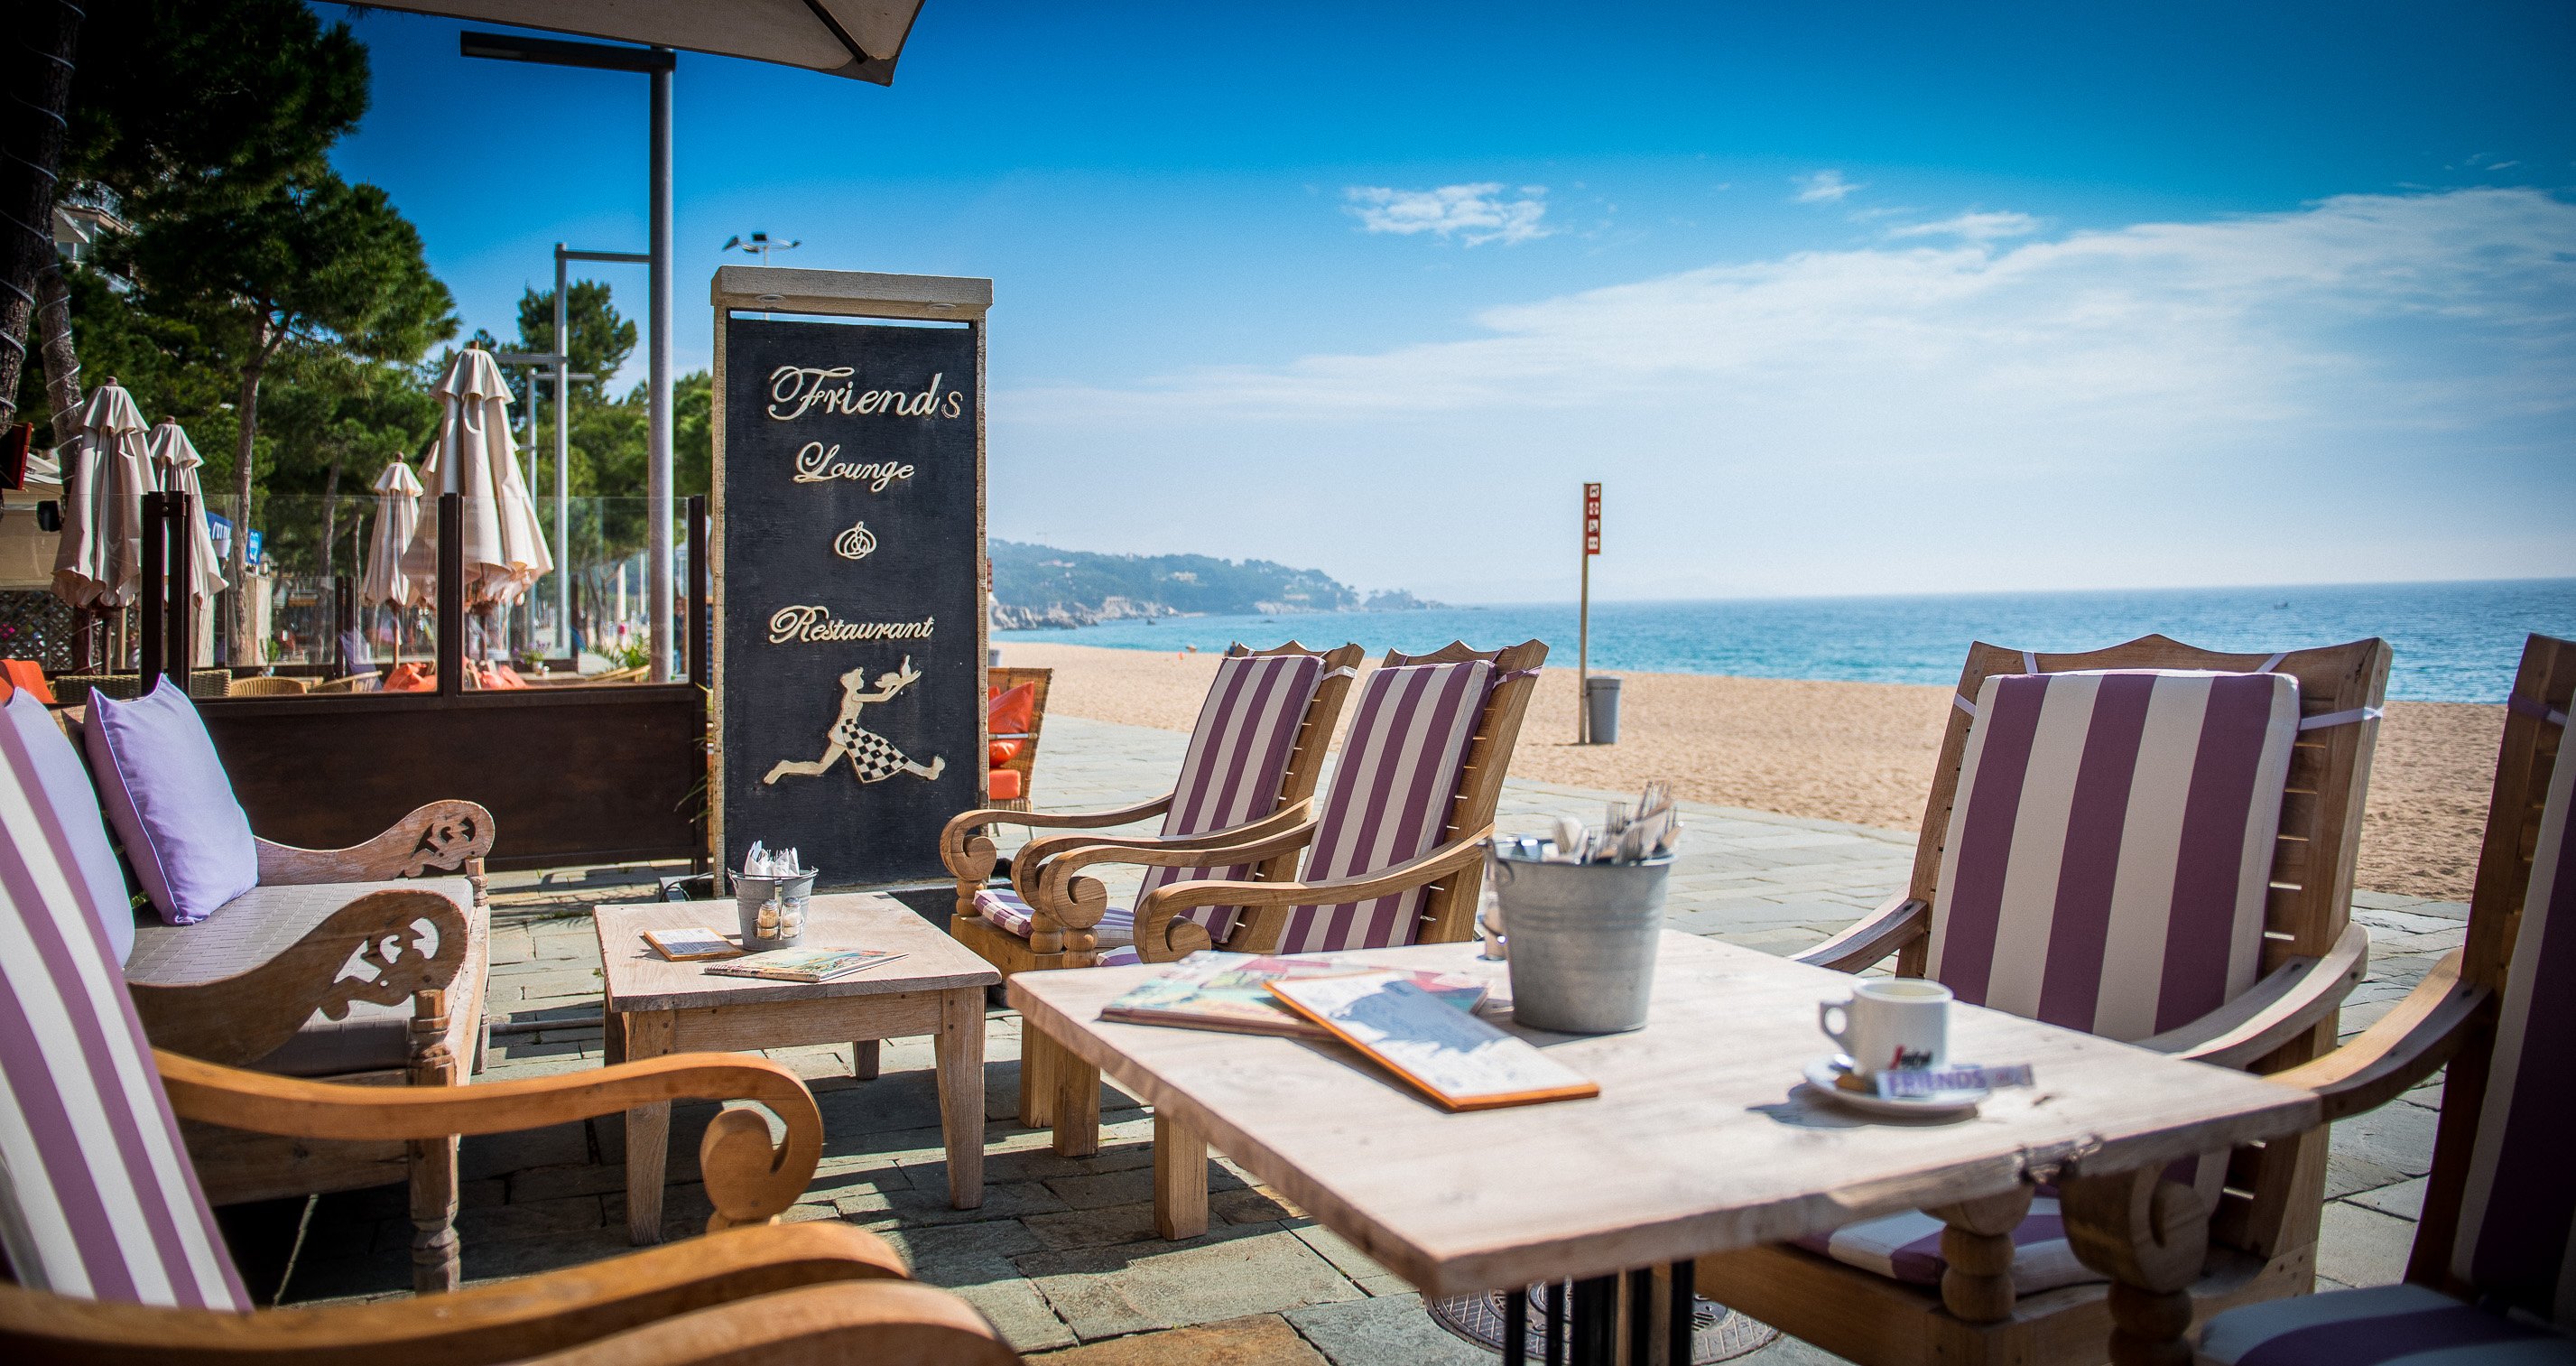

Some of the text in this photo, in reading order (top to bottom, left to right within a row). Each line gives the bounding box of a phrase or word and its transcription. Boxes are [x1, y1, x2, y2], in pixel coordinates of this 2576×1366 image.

[768, 366, 963, 420] Friends
[793, 441, 914, 492] Lounge
[769, 604, 934, 644] Restaurant
